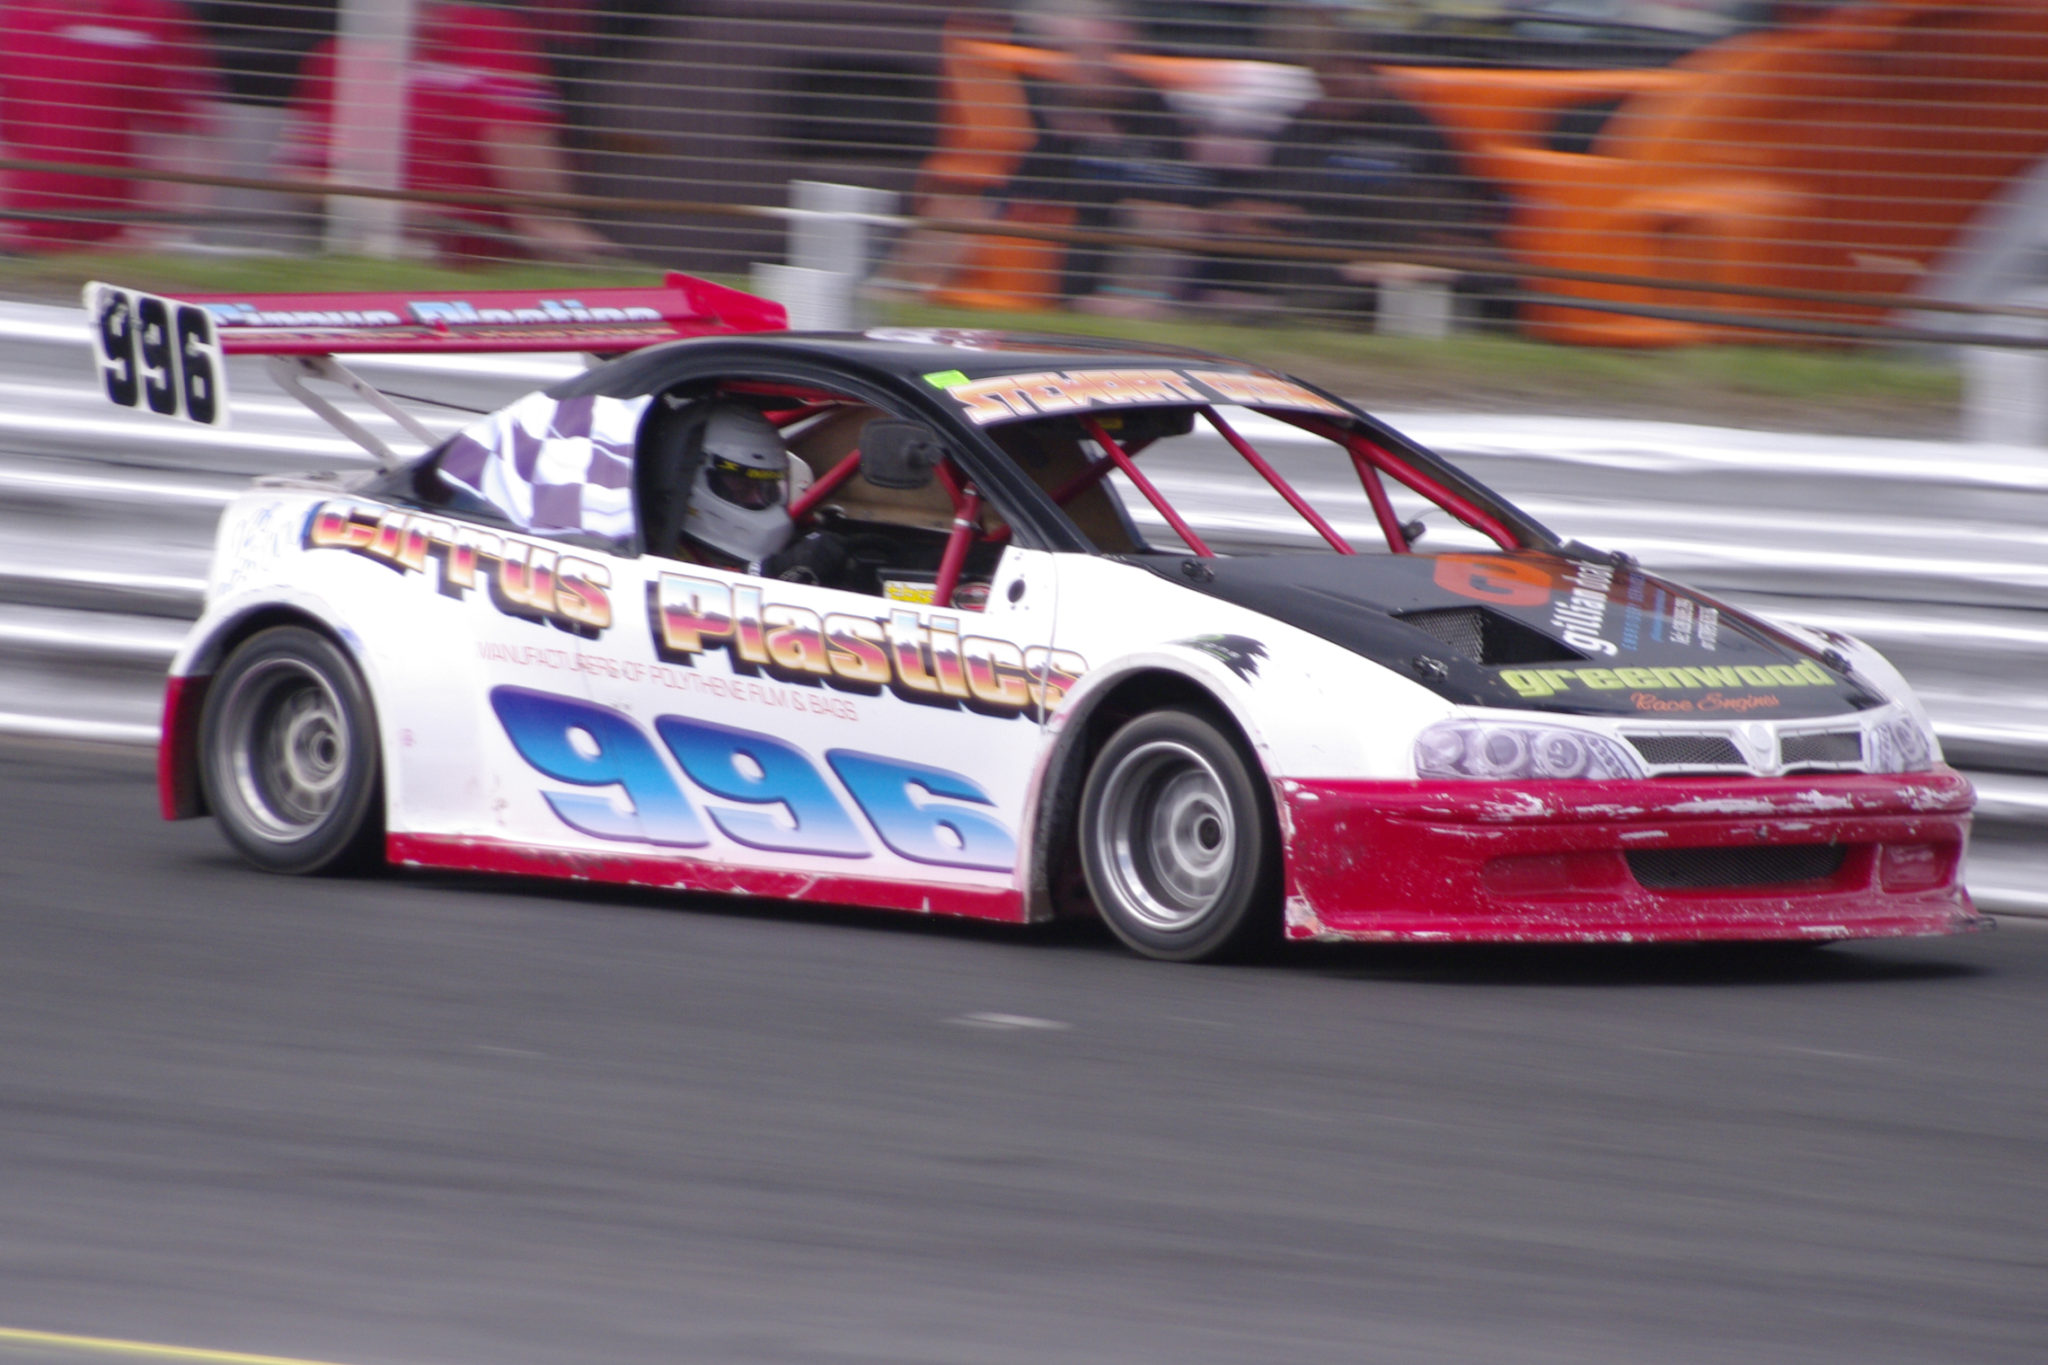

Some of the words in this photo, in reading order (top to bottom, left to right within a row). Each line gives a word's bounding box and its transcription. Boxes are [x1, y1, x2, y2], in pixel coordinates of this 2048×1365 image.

[100, 287, 215, 425] 996
[945, 369, 1211, 424] STEWART
[647, 571, 1088, 722] Plastics
[1550, 587, 1618, 657] gillian
[477, 640, 621, 680] MANUFACTURERS
[622, 660, 646, 682] OF
[648, 664, 748, 702] POLYTHENE
[747, 682, 790, 709] FILM
[807, 693, 859, 722] BAGS
[1500, 658, 1837, 698] greenwood
[488, 683, 1018, 875] 996
